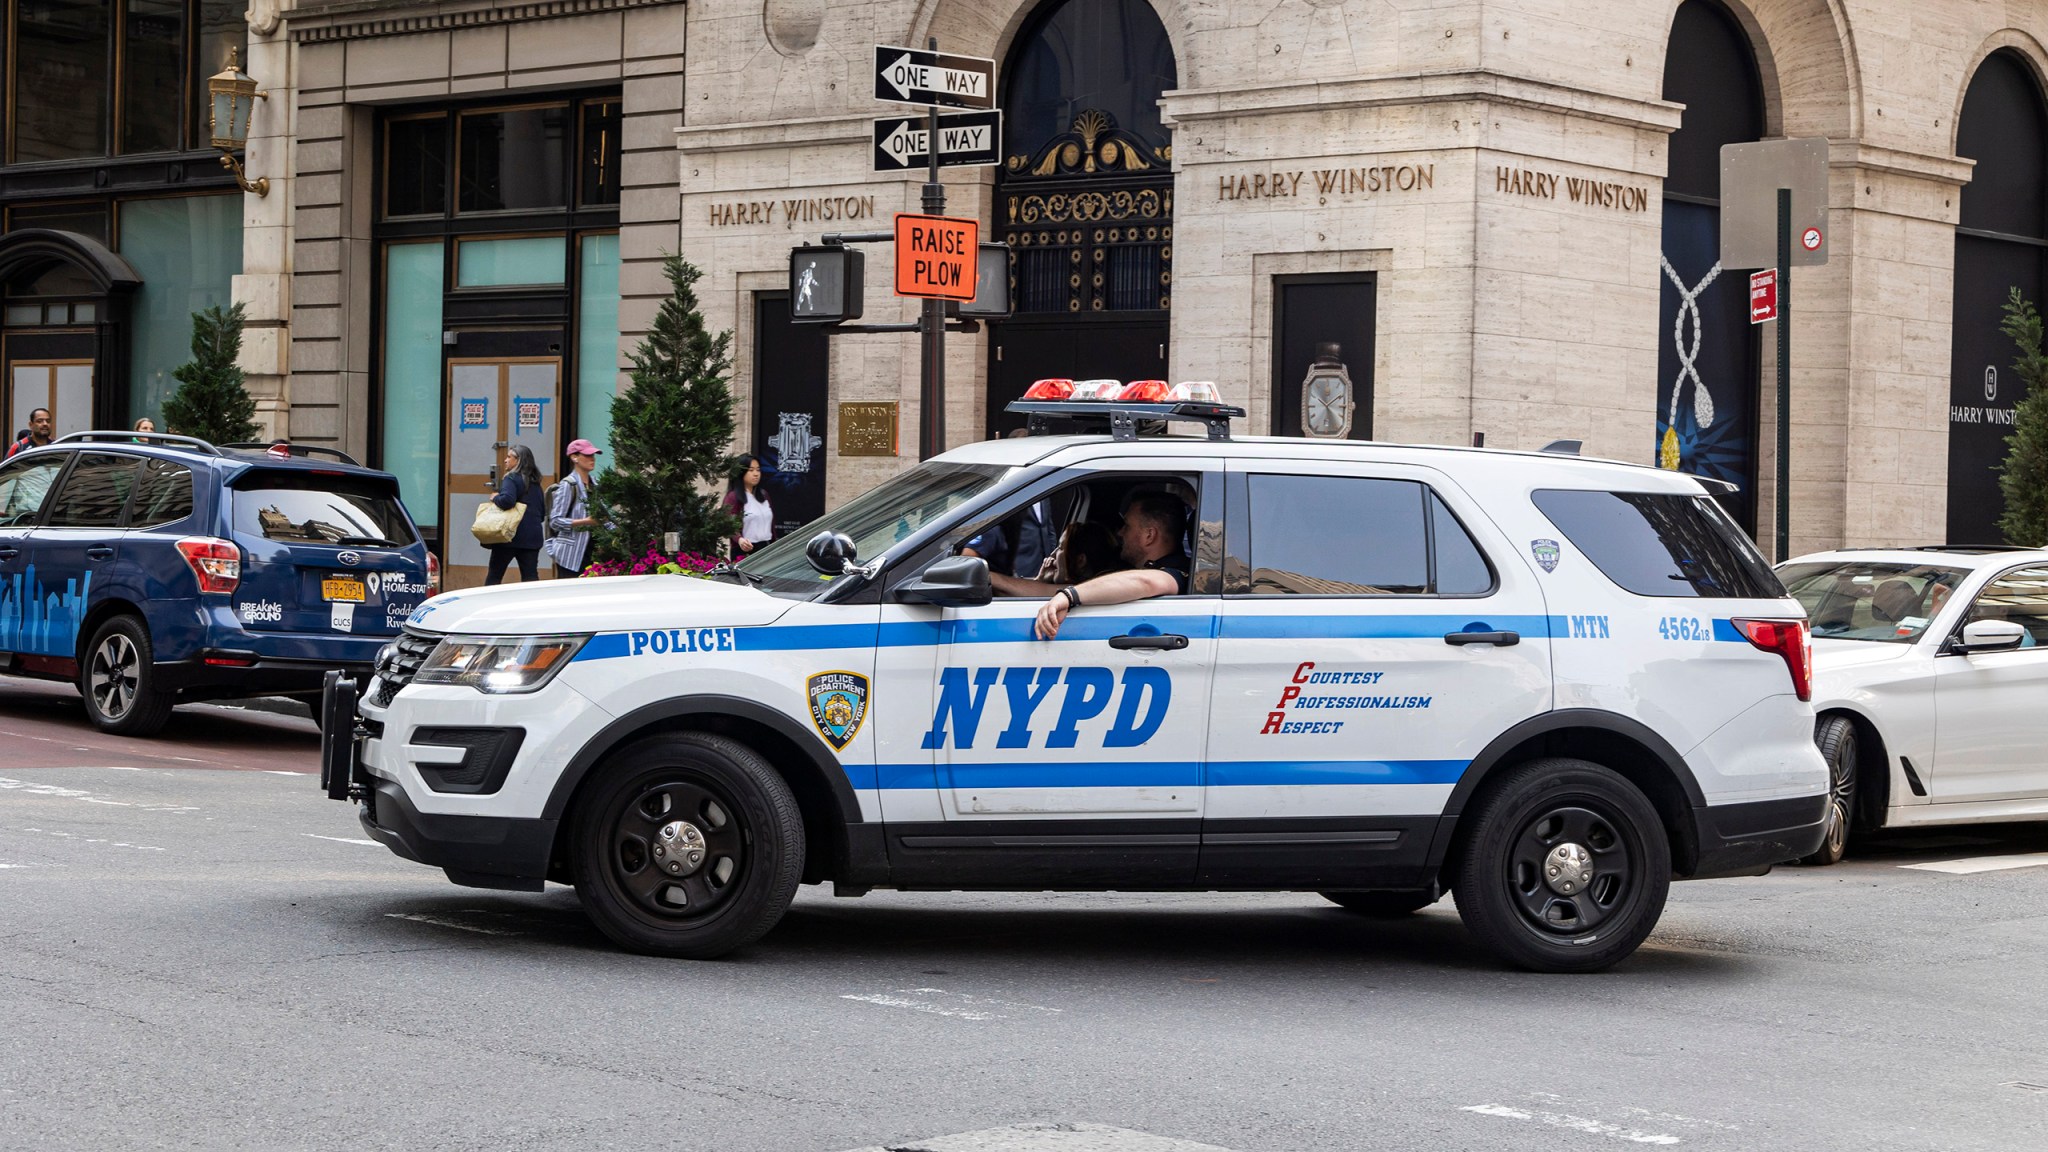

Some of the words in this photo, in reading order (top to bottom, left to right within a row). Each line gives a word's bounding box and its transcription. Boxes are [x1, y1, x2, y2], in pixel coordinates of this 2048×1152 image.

[895, 65, 929, 88] ONE
[945, 71, 979, 94] WAY
[893, 133, 927, 154] ONE
[945, 128, 983, 150] WAY
[1219, 171, 1303, 200] HARRY
[1312, 164, 1434, 194] WINSTON
[1496, 166, 1560, 199] HARRY
[1566, 176, 1647, 212] WINSTON
[709, 201, 775, 226] HARRY
[782, 195, 874, 222] WINSTON
[912, 227, 965, 255] RAISE
[915, 260, 962, 287] PLOW
[1950, 405, 1983, 423] HARRY
[382, 572, 406, 583] NYC
[382, 582, 427, 594] HOME-STAT
[240, 599, 282, 613] BREAKING
[244, 611, 282, 624] GROUND
[333, 618, 351, 627] CUCS
[1571, 615, 1610, 639] MTN
[1658, 617, 1700, 641] 4562
[632, 628, 732, 654] POLICE
[810, 682, 865, 697] DEPARTMENT
[821, 674, 854, 685] POLICE
[920, 666, 1172, 749] NYPD
[812, 705, 825, 725] CITY
[822, 726, 833, 737] OF
[842, 723, 857, 741] NEW
[855, 701, 866, 722] YORK
